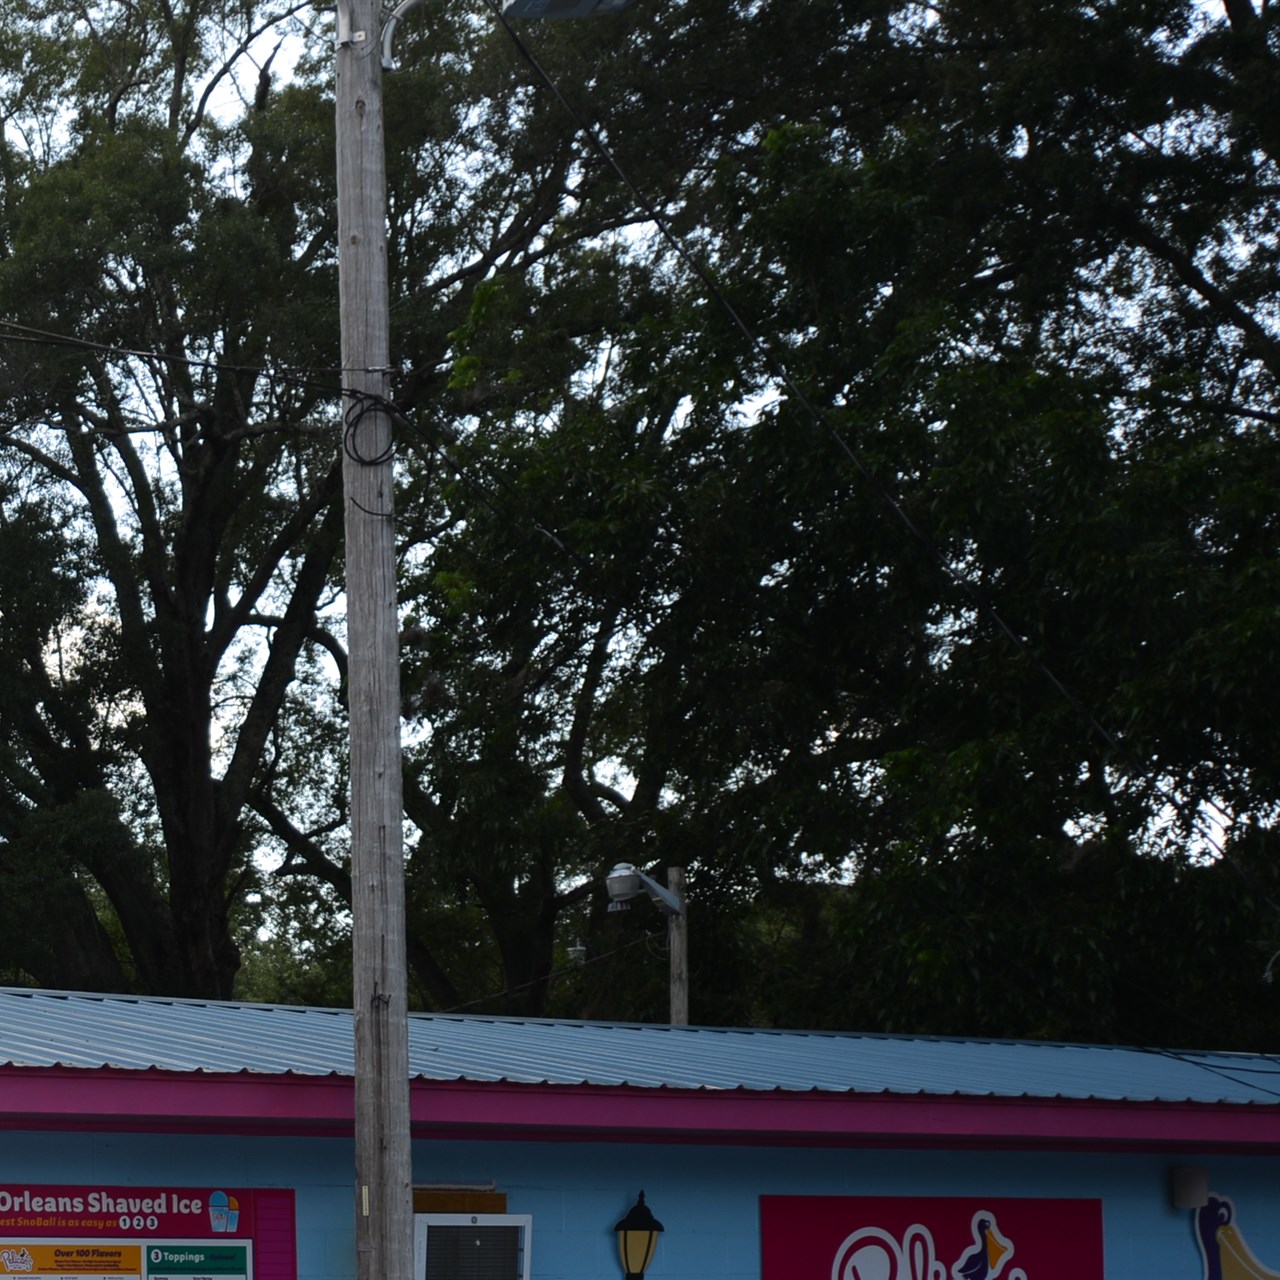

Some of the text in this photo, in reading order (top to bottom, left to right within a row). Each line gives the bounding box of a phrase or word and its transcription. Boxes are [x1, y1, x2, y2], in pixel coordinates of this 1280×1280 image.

[87, 1191, 167, 1214] Shaved
[172, 1193, 202, 1214] Ice
[17, 1217, 57, 1227] SnoBall
[58, 1217, 66, 1227] is
[68, 1219, 80, 1227] as
[81, 1219, 104, 1229] easy
[105, 1220, 118, 1228] as
[54, 1249, 122, 1258] Over 100 Flavors
[163, 1252, 205, 1263] Toppings
